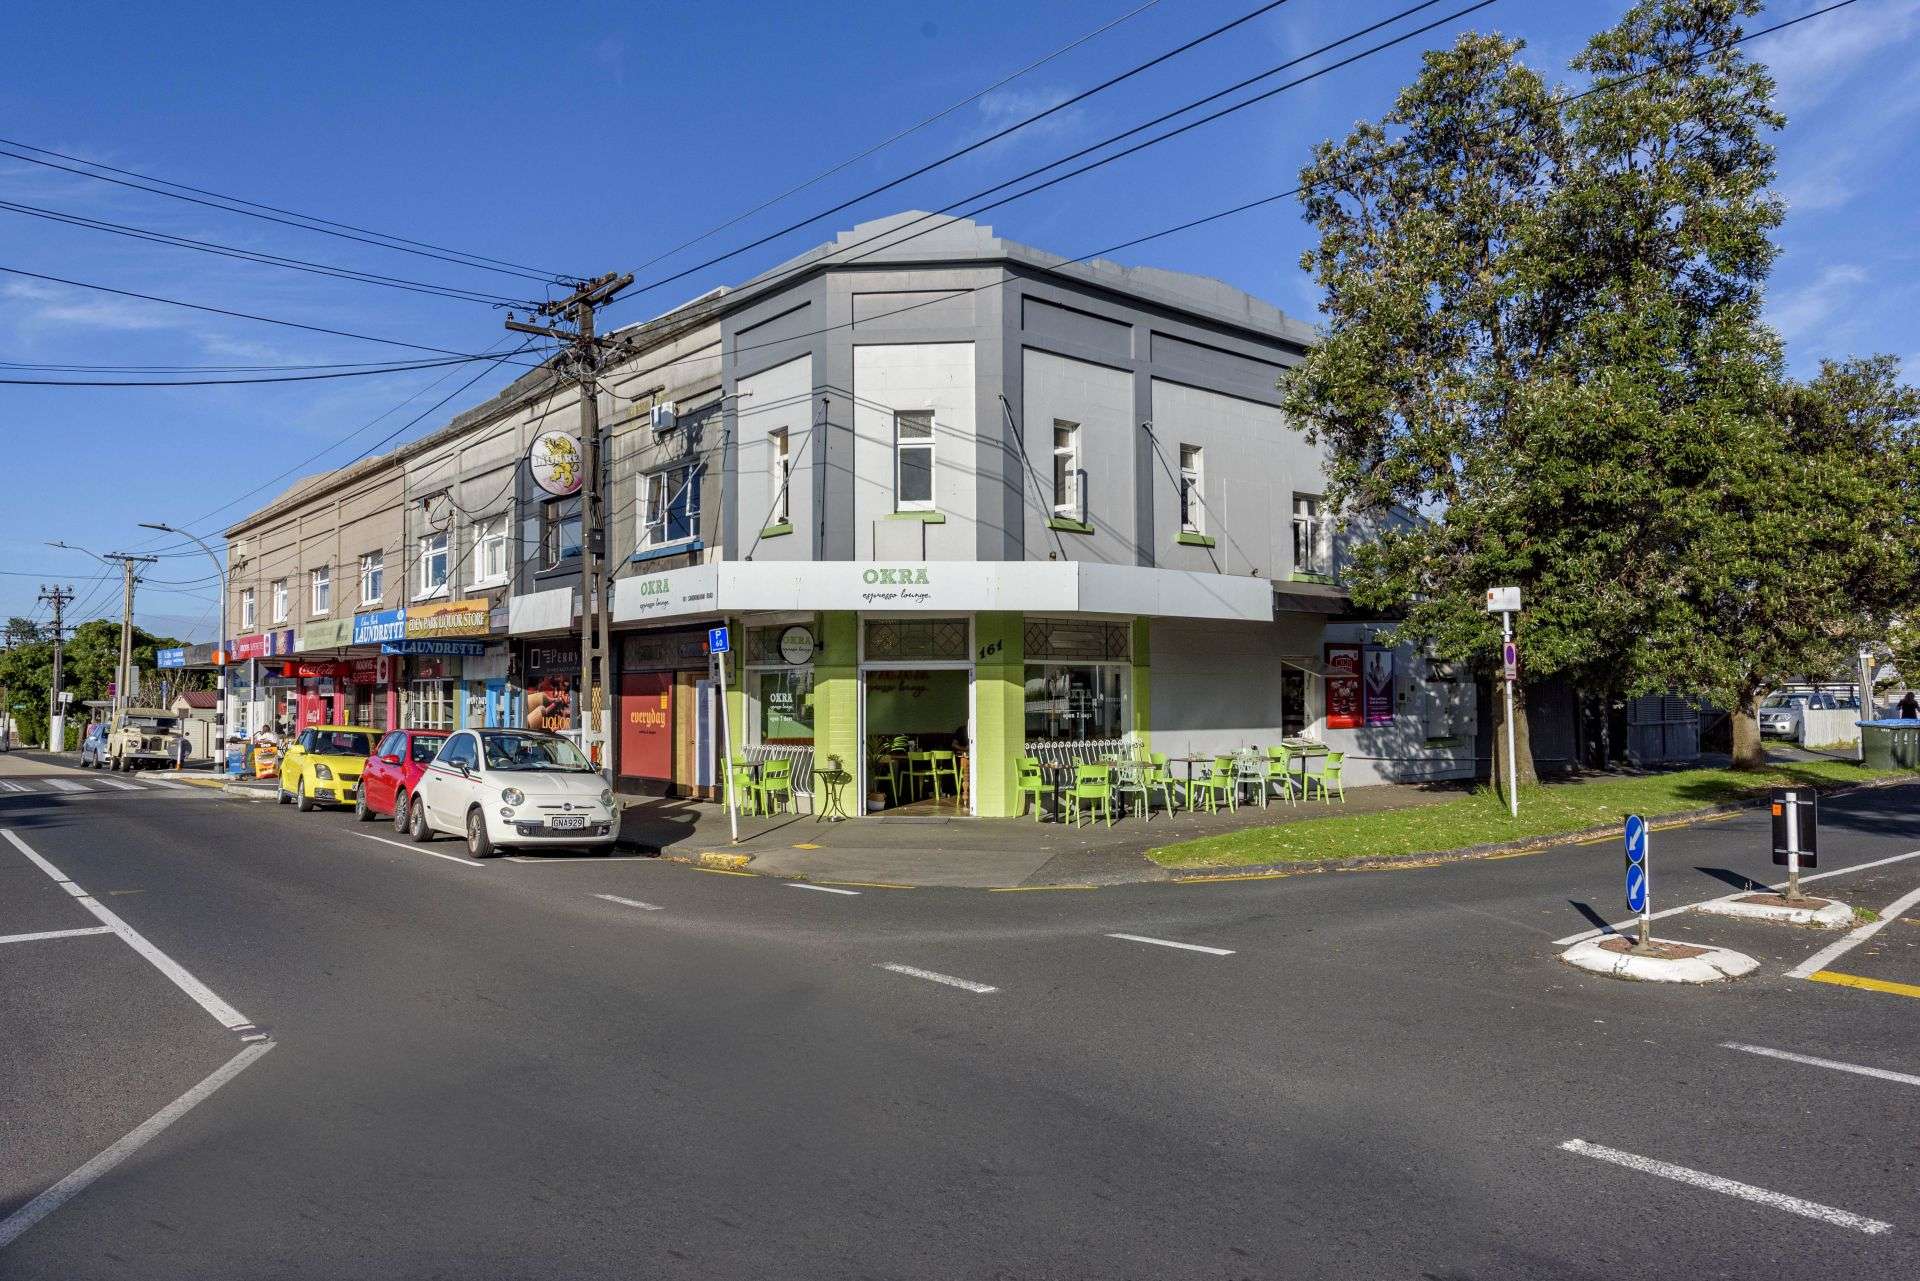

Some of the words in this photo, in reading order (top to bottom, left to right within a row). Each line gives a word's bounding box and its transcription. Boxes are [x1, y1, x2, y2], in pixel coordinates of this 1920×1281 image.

[863, 569, 930, 584] OKRA
[640, 579, 670, 596] OKRA
[863, 592, 898, 604] espresso
[409, 618, 423, 631] EDEN
[423, 616, 439, 629] PARK
[439, 613, 464, 630] LIQUOR
[464, 612, 485, 627] STORE
[354, 621, 405, 644] LAUNDRETTE
[715, 630, 722, 640] P
[401, 641, 484, 655] LAUNDRETTE
[979, 639, 1003, 659] 161
[769, 693, 793, 703] OKRA
[630, 707, 667, 727] everyday
[553, 818, 584, 828] GNA929
